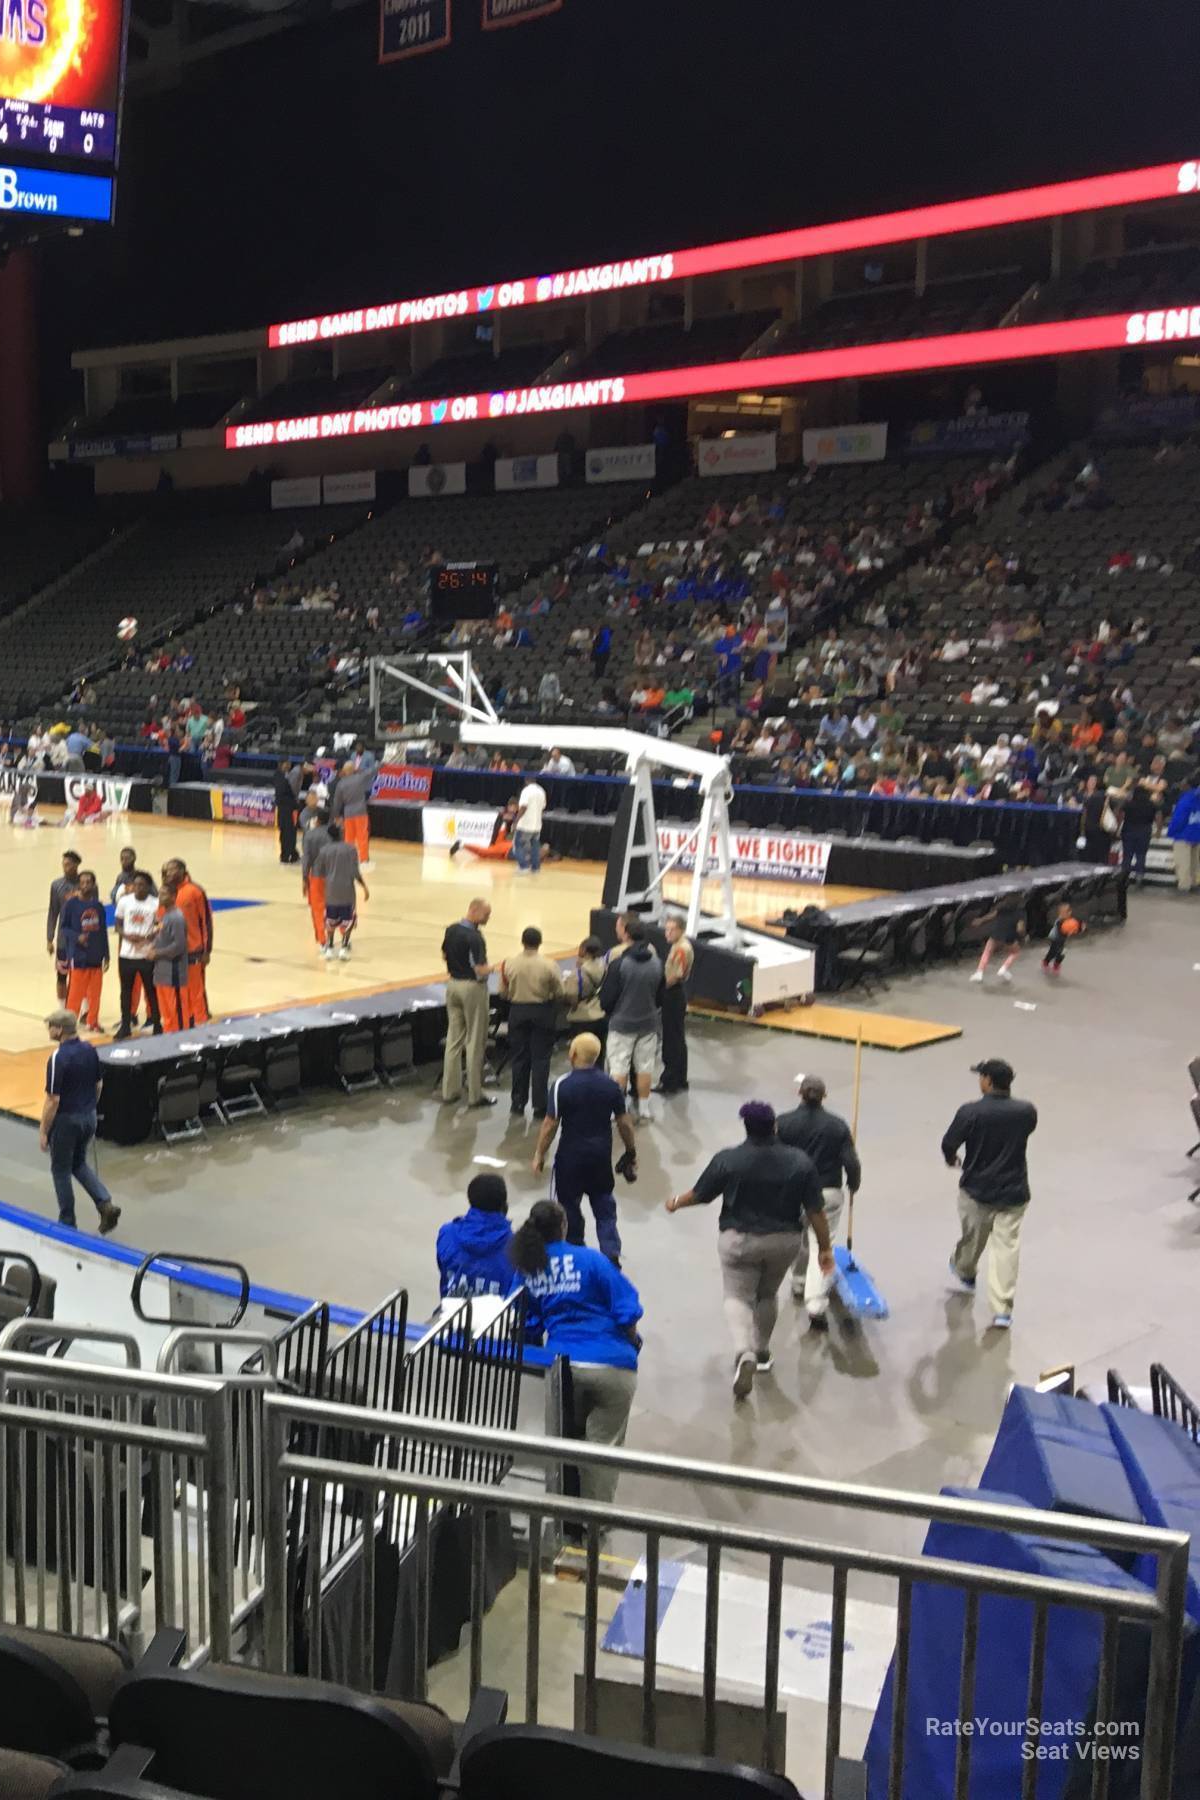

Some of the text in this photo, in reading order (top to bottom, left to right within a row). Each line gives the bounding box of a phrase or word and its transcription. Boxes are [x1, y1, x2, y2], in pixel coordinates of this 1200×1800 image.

[399, 11, 431, 46] 2011
[80, 110, 105, 129] BATS
[83, 133, 94, 154] 0
[1176, 160, 1200, 192] S
[278, 318, 318, 345] SEND
[320, 308, 363, 338] GAME
[366, 303, 397, 330] DAY
[399, 291, 468, 325] PHOTOS
[498, 281, 525, 308] OR
[235, 423, 275, 447] SEND
[276, 416, 318, 443] GAME
[321, 411, 352, 435] DAY
[353, 402, 422, 433] PHOTOS
[451, 396, 478, 421] OR
[438, 571, 487, 589] 26:14
[676, 831, 718, 856] HUT
[735, 836, 761, 859] WE
[766, 838, 824, 866] FIGHT!
